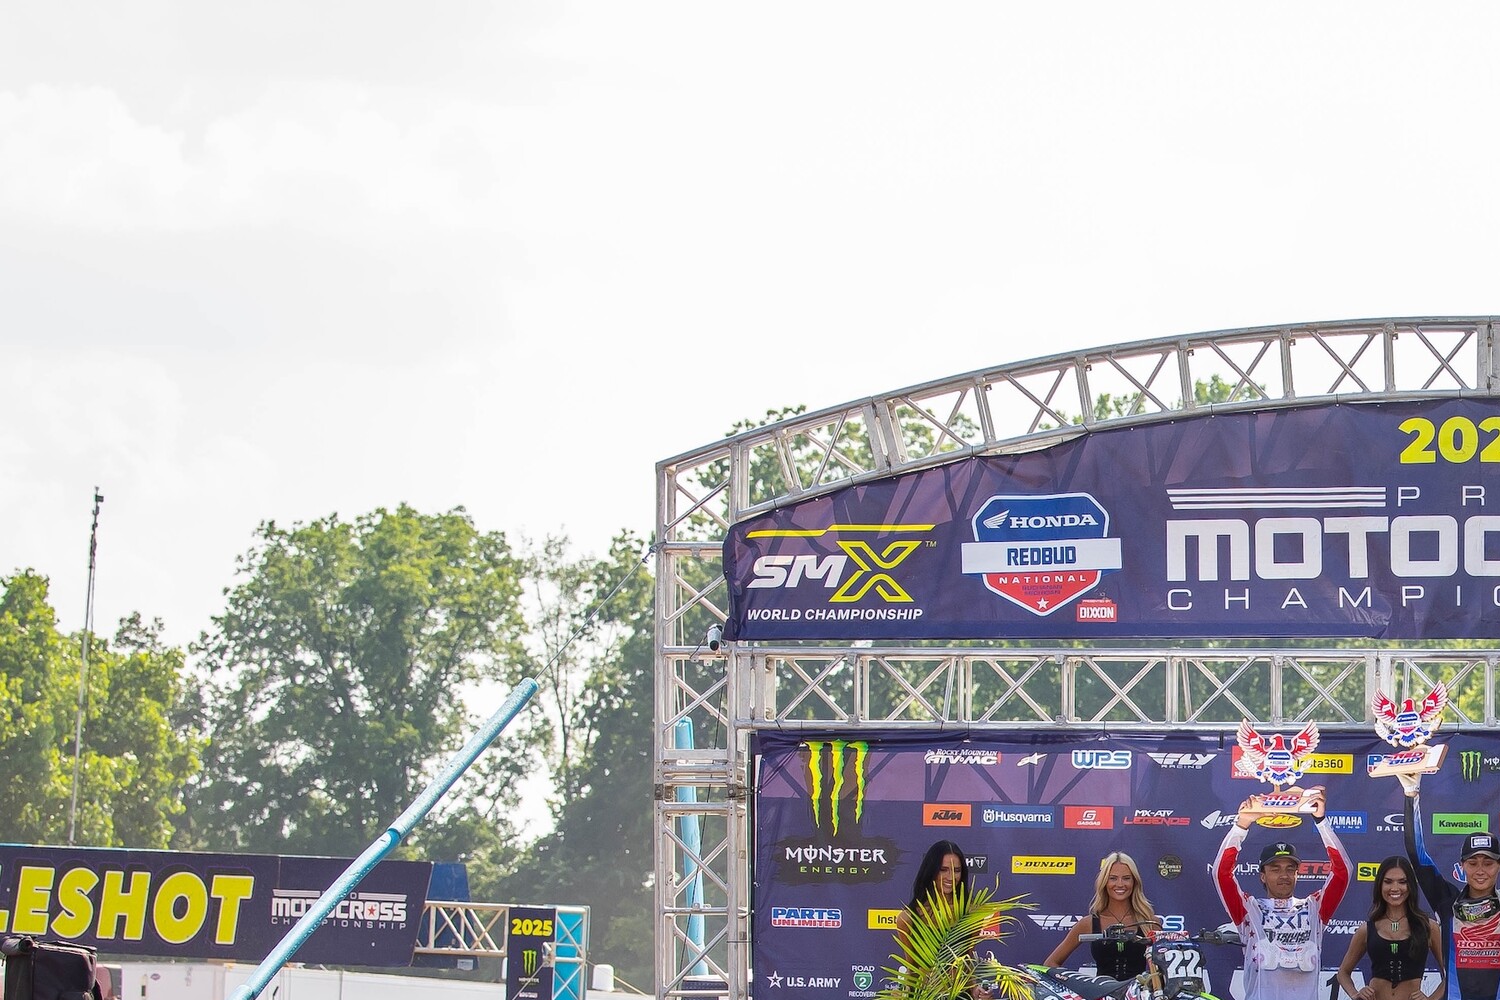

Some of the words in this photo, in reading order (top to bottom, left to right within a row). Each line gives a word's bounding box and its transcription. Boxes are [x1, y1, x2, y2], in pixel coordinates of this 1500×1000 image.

[1009, 513, 1099, 529] HONDA
[1006, 546, 1077, 567] REDBUD
[746, 540, 923, 604] SMX
[998, 574, 1087, 585] NATIONAL
[747, 608, 802, 621] WORLD
[804, 608, 923, 621] CHAMPIONSHIP
[1079, 606, 1115, 620] DIXXON
[1073, 750, 1131, 769] WPS
[1147, 752, 1218, 765] FLY
[931, 809, 964, 821] KTM
[995, 811, 1052, 824] Husqvarna
[1134, 809, 1175, 817] MX-ATV
[1122, 816, 1191, 826] LEGENDS
[1257, 815, 1302, 827] FMF
[1328, 815, 1363, 826] YAMAHA
[1438, 818, 1483, 829] Kawasaki
[785, 844, 887, 864] MONSTER
[799, 866, 870, 874] ENERGY
[1023, 860, 1073, 869] DUNLOP
[271, 897, 408, 922] MOCROSS
[772, 908, 841, 920] PARTS
[271, 917, 407, 930] CHPIONSHIP
[511, 919, 553, 937] 2025
[772, 918, 841, 928] UNLIMITED
[1163, 949, 1202, 979] 22
[786, 977, 807, 988] U.S.
[808, 977, 841, 988] ARMY
[858, 977, 867, 988] 2
[848, 990, 876, 998] RECOVERY
